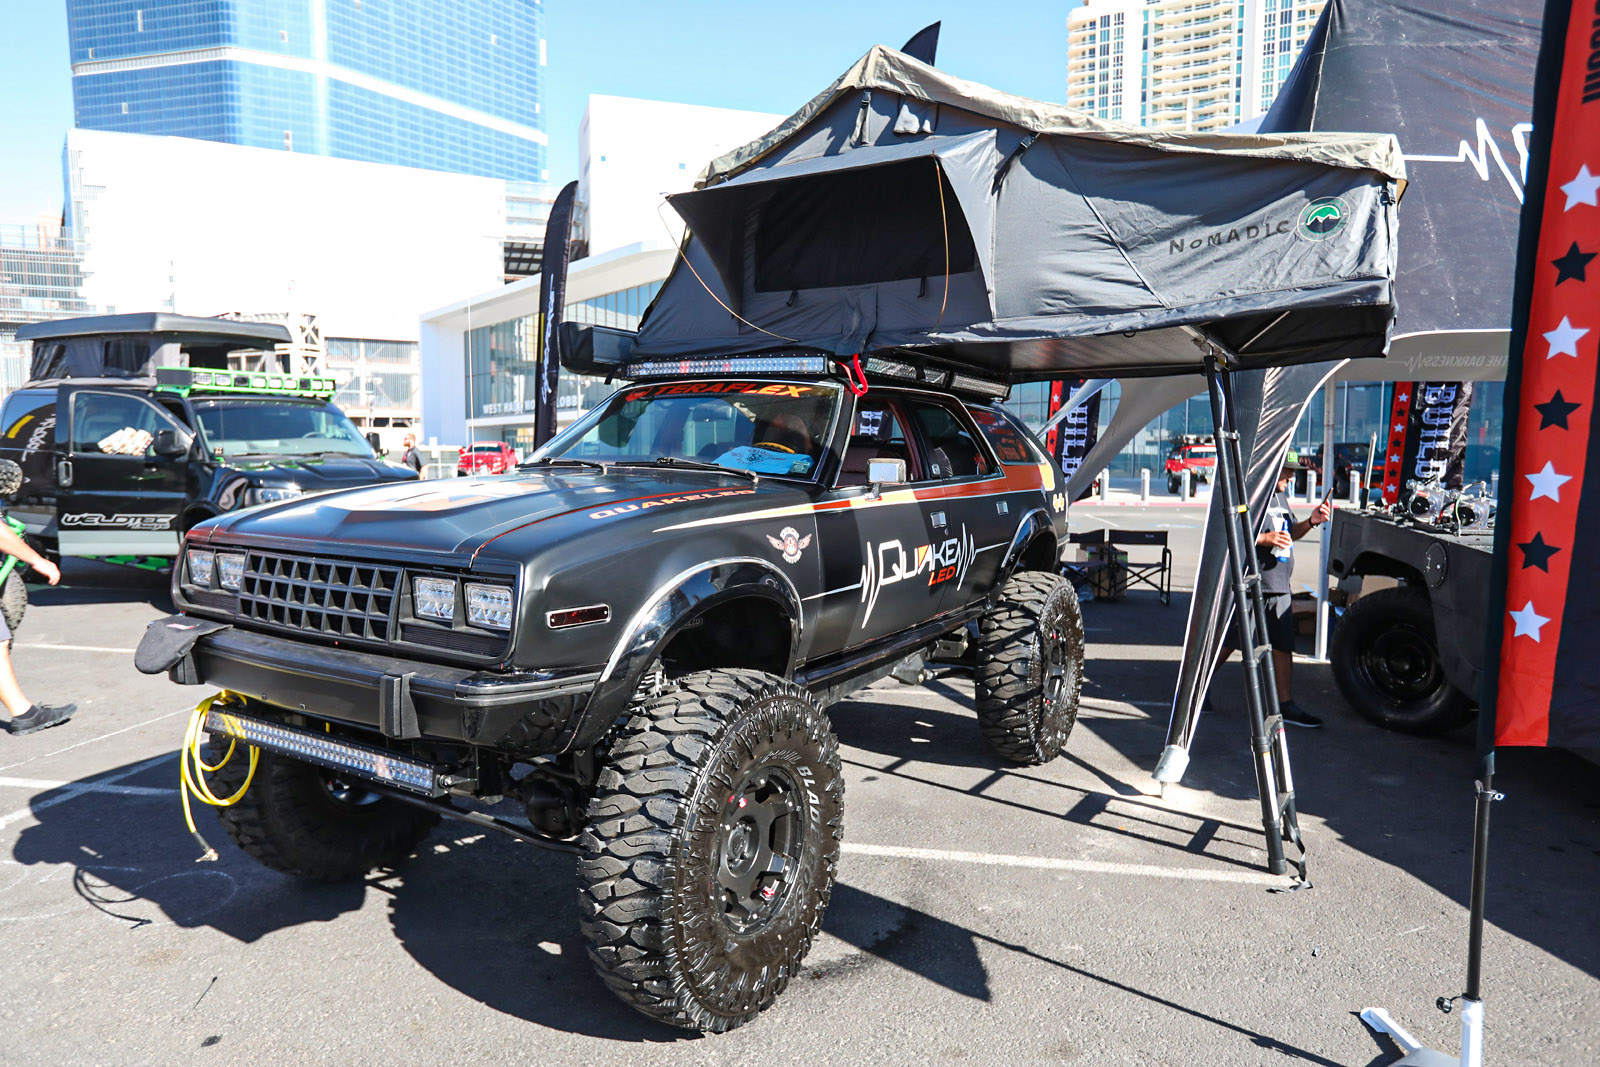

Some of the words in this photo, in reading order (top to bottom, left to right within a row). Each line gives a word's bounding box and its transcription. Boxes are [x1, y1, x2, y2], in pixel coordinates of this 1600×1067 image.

[654, 383, 812, 398] TERAFLEX
[483, 403, 502, 414] WEST
[590, 489, 756, 520] QUAKELED
[878, 538, 958, 586] QUAKE
[928, 565, 957, 587] LED
